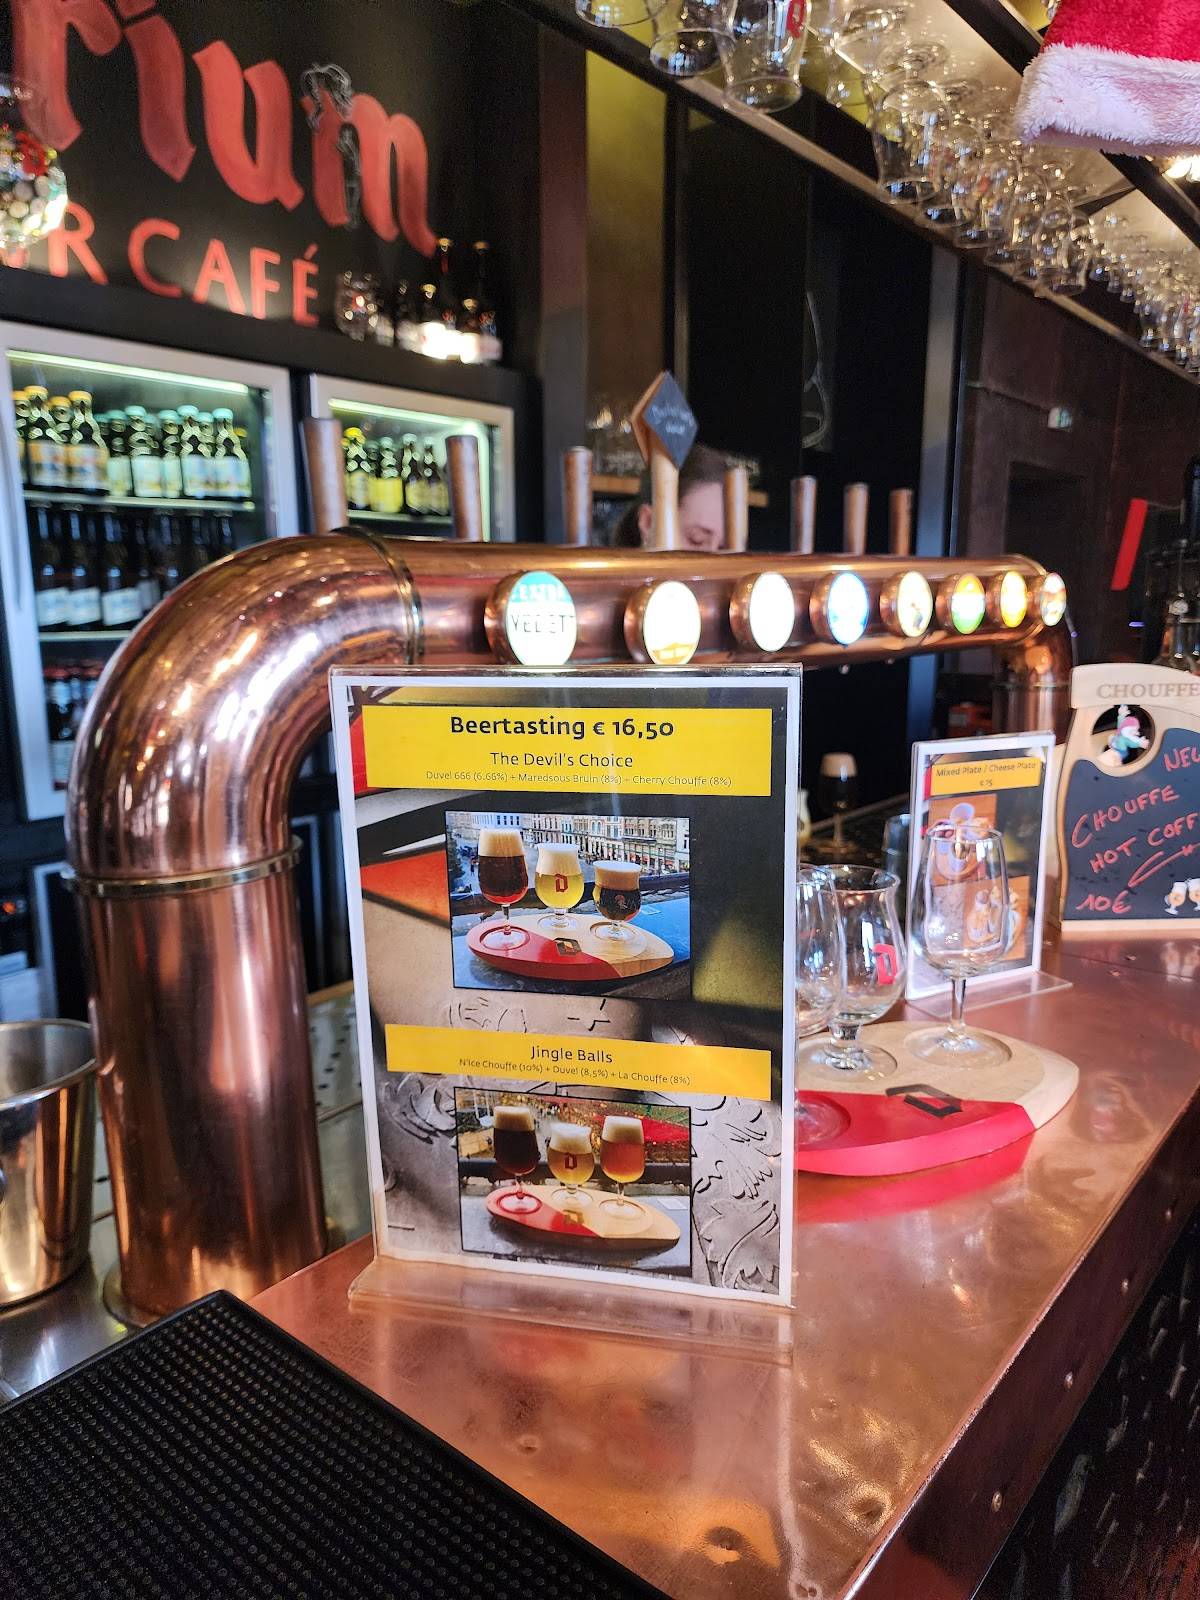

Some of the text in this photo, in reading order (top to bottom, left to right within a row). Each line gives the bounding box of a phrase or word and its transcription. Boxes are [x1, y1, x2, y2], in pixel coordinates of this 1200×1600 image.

[128, 217, 319, 327] CAFÉ
[1097, 683, 1200, 699] CHOUFFE
[451, 715, 674, 740] Beertasting € 16,50
[490, 752, 633, 768] The Devil's Choice
[426, 771, 452, 780] Duvel
[454, 771, 471, 780] 666
[518, 773, 570, 783] Maredsous
[573, 774, 599, 784] Bruin
[632, 775, 666, 785] Cherry
[667, 775, 707, 786] Chouffe
[709, 776, 732, 787] (8%)
[936, 768, 960, 777] Mixed
[962, 766, 982, 774] Plate
[1072, 784, 1180, 849] CHOUFFE
[1089, 836, 1137, 874] HOT
[530, 1045, 613, 1064] Jingle Balls
[482, 1060, 518, 1071] Chouffe
[519, 1063, 543, 1074] (10%)
[553, 1065, 578, 1075] Duvel
[618, 1071, 629, 1080] La
[631, 1072, 668, 1084] Chouffe
[669, 1075, 692, 1086] (8%)
